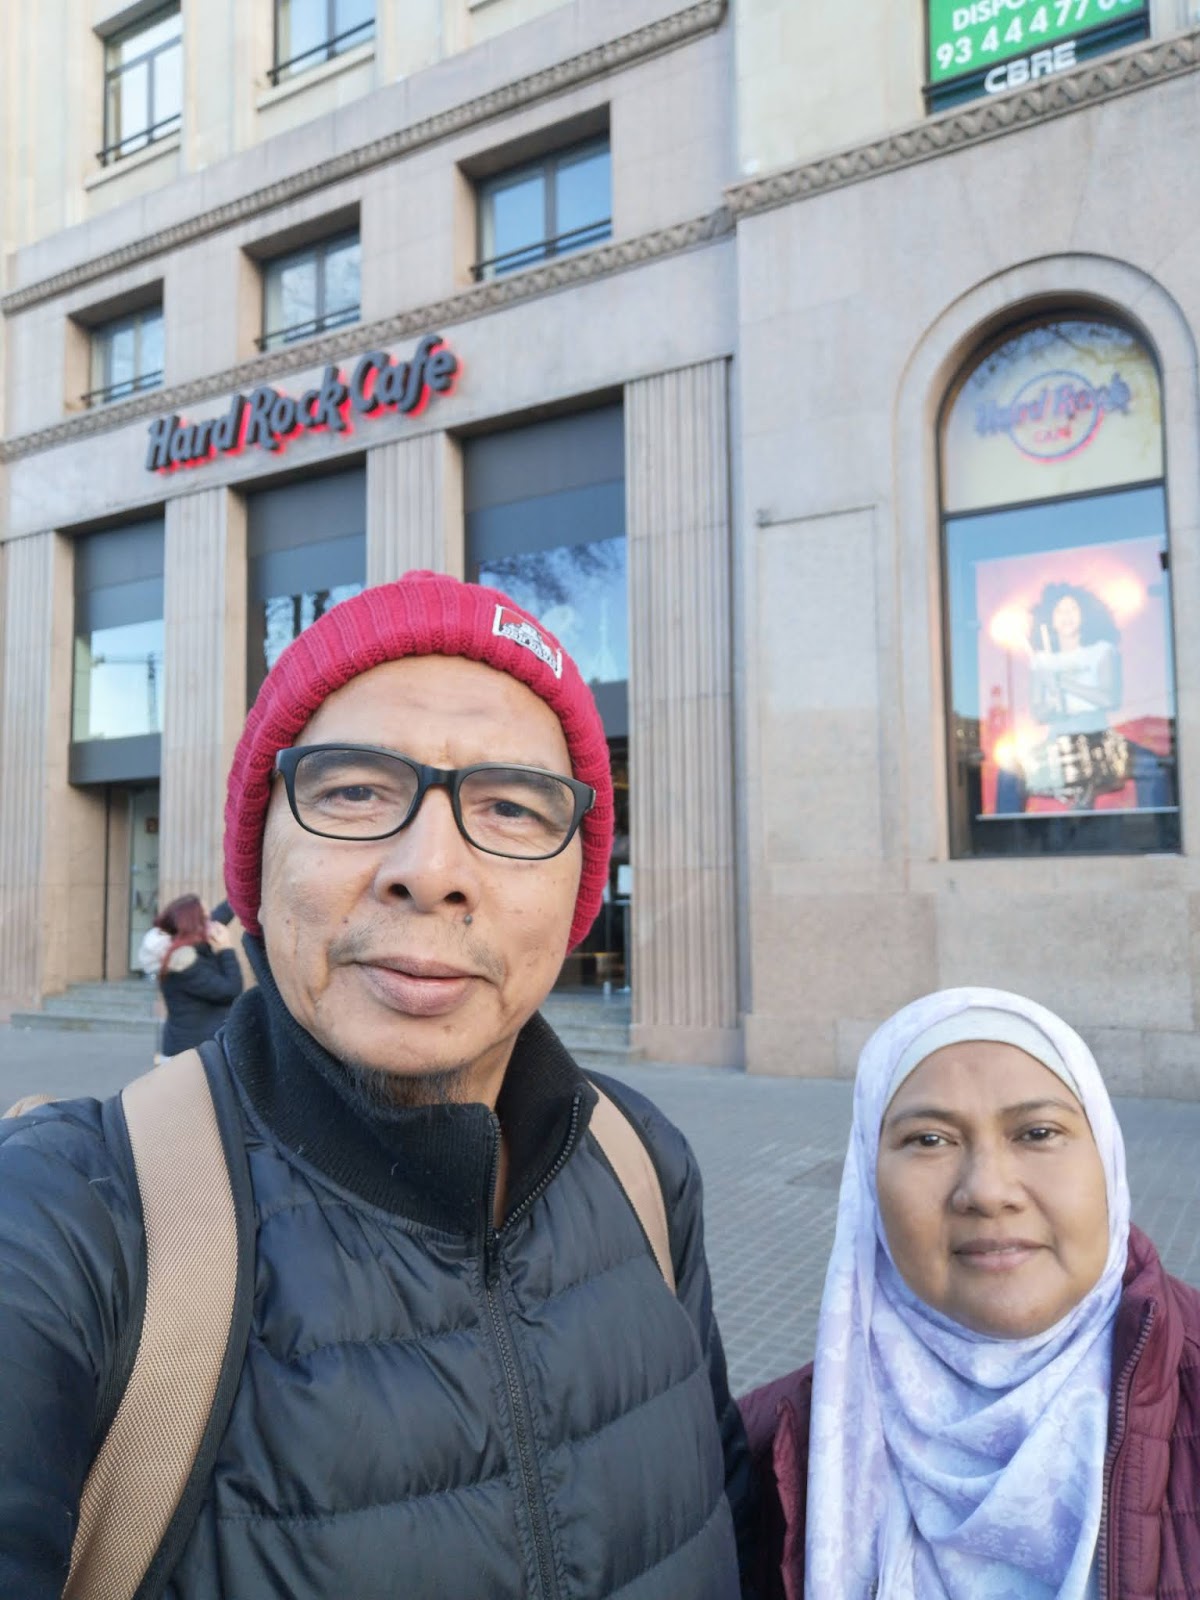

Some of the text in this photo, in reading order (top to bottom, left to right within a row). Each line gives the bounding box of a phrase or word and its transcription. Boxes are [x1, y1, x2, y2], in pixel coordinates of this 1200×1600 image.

[984, 40, 1077, 93] CBRE
[146, 332, 458, 471] Hard Rock Cafe
